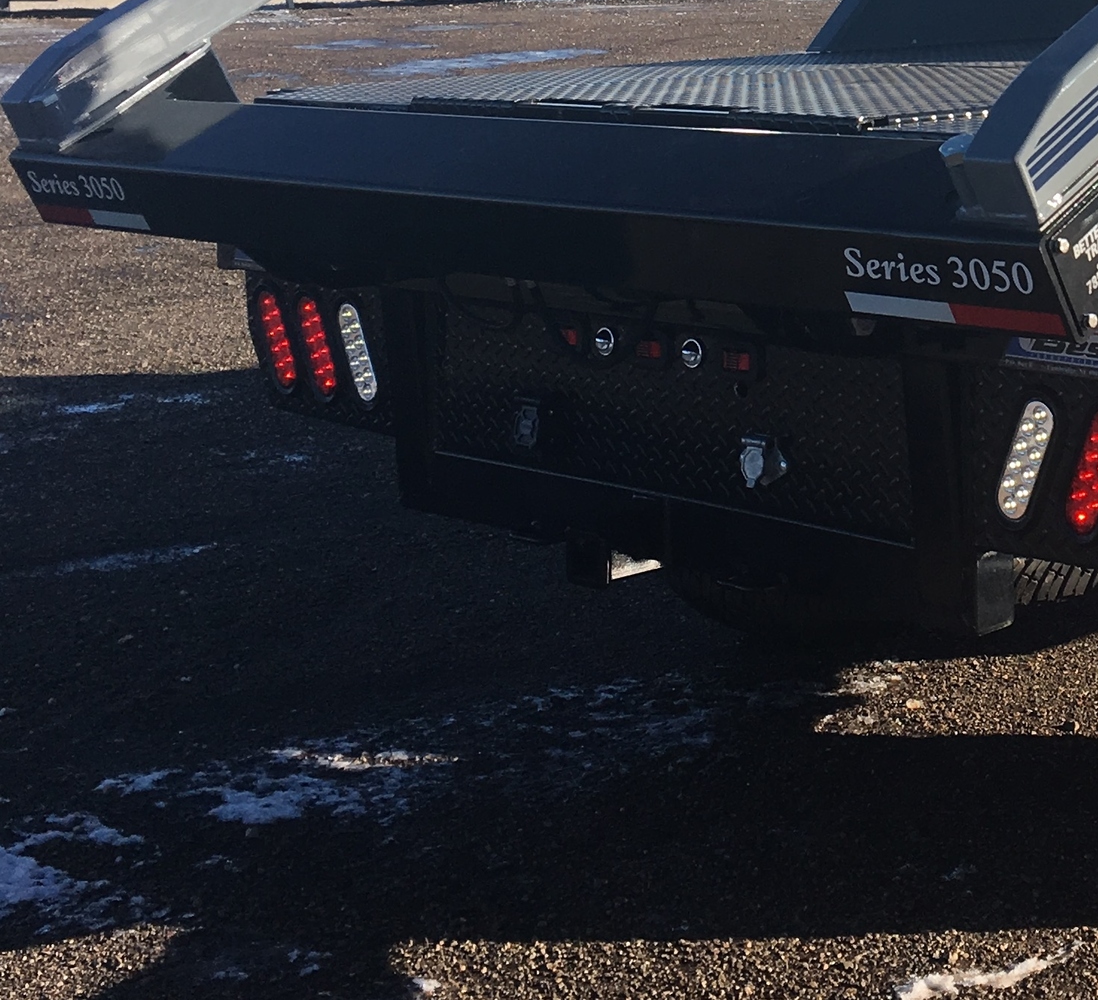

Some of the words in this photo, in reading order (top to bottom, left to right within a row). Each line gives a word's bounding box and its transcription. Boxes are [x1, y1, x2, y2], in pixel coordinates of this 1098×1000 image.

[27, 170, 80, 196] Series
[78, 174, 125, 201] 3050
[843, 247, 941, 286] Series
[947, 256, 1034, 295] 3050
